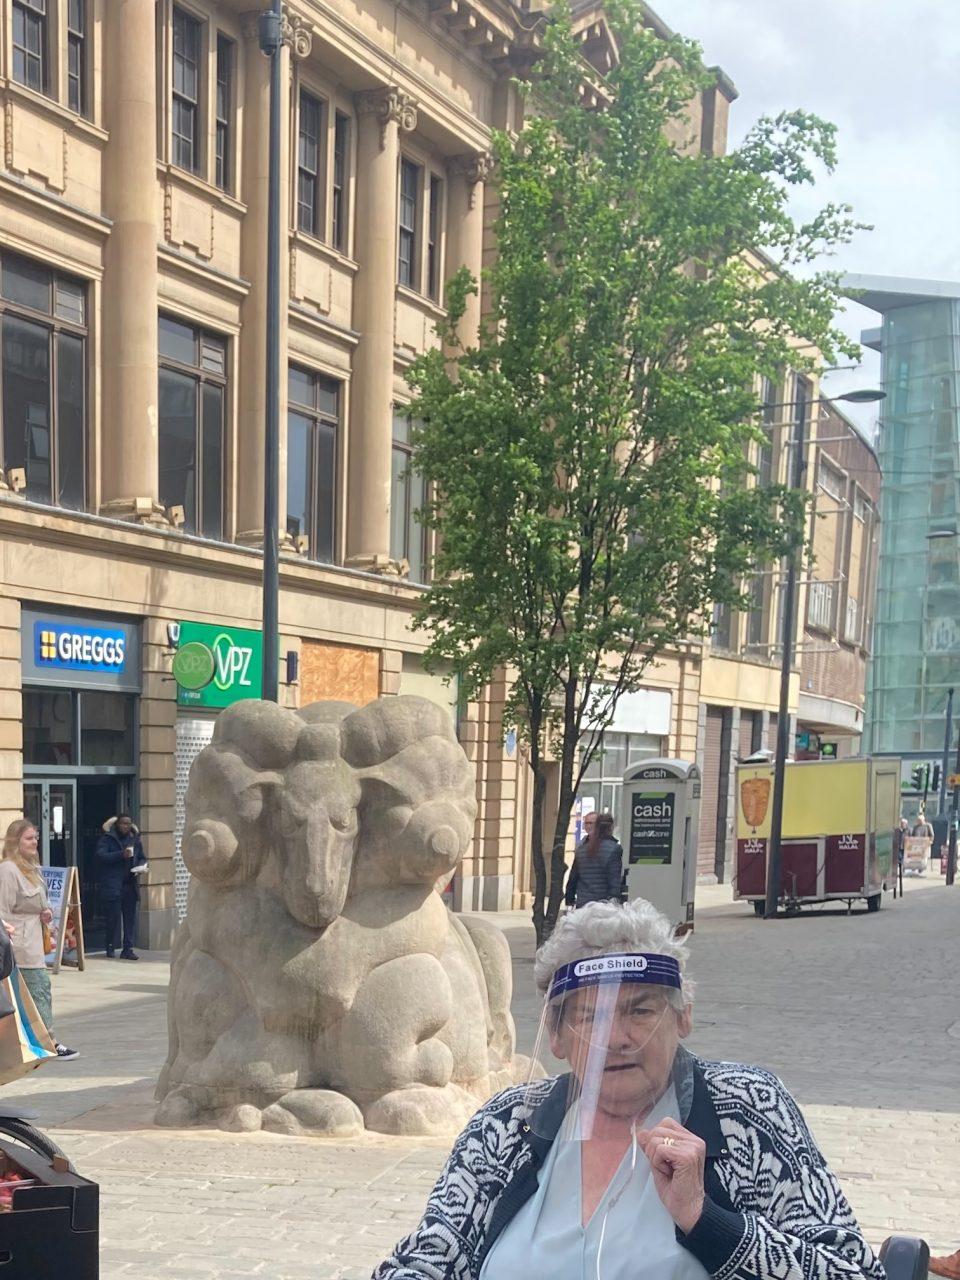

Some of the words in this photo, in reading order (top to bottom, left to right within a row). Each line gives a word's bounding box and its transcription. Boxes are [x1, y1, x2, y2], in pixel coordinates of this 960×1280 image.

[58, 632, 125, 664] GREGGS
[176, 651, 208, 673] VPZ
[216, 643, 253, 686] VPZ
[643, 769, 667, 778] cash
[634, 802, 672, 817] cash
[578, 962, 604, 973] Face
[607, 959, 643, 969] Shield
